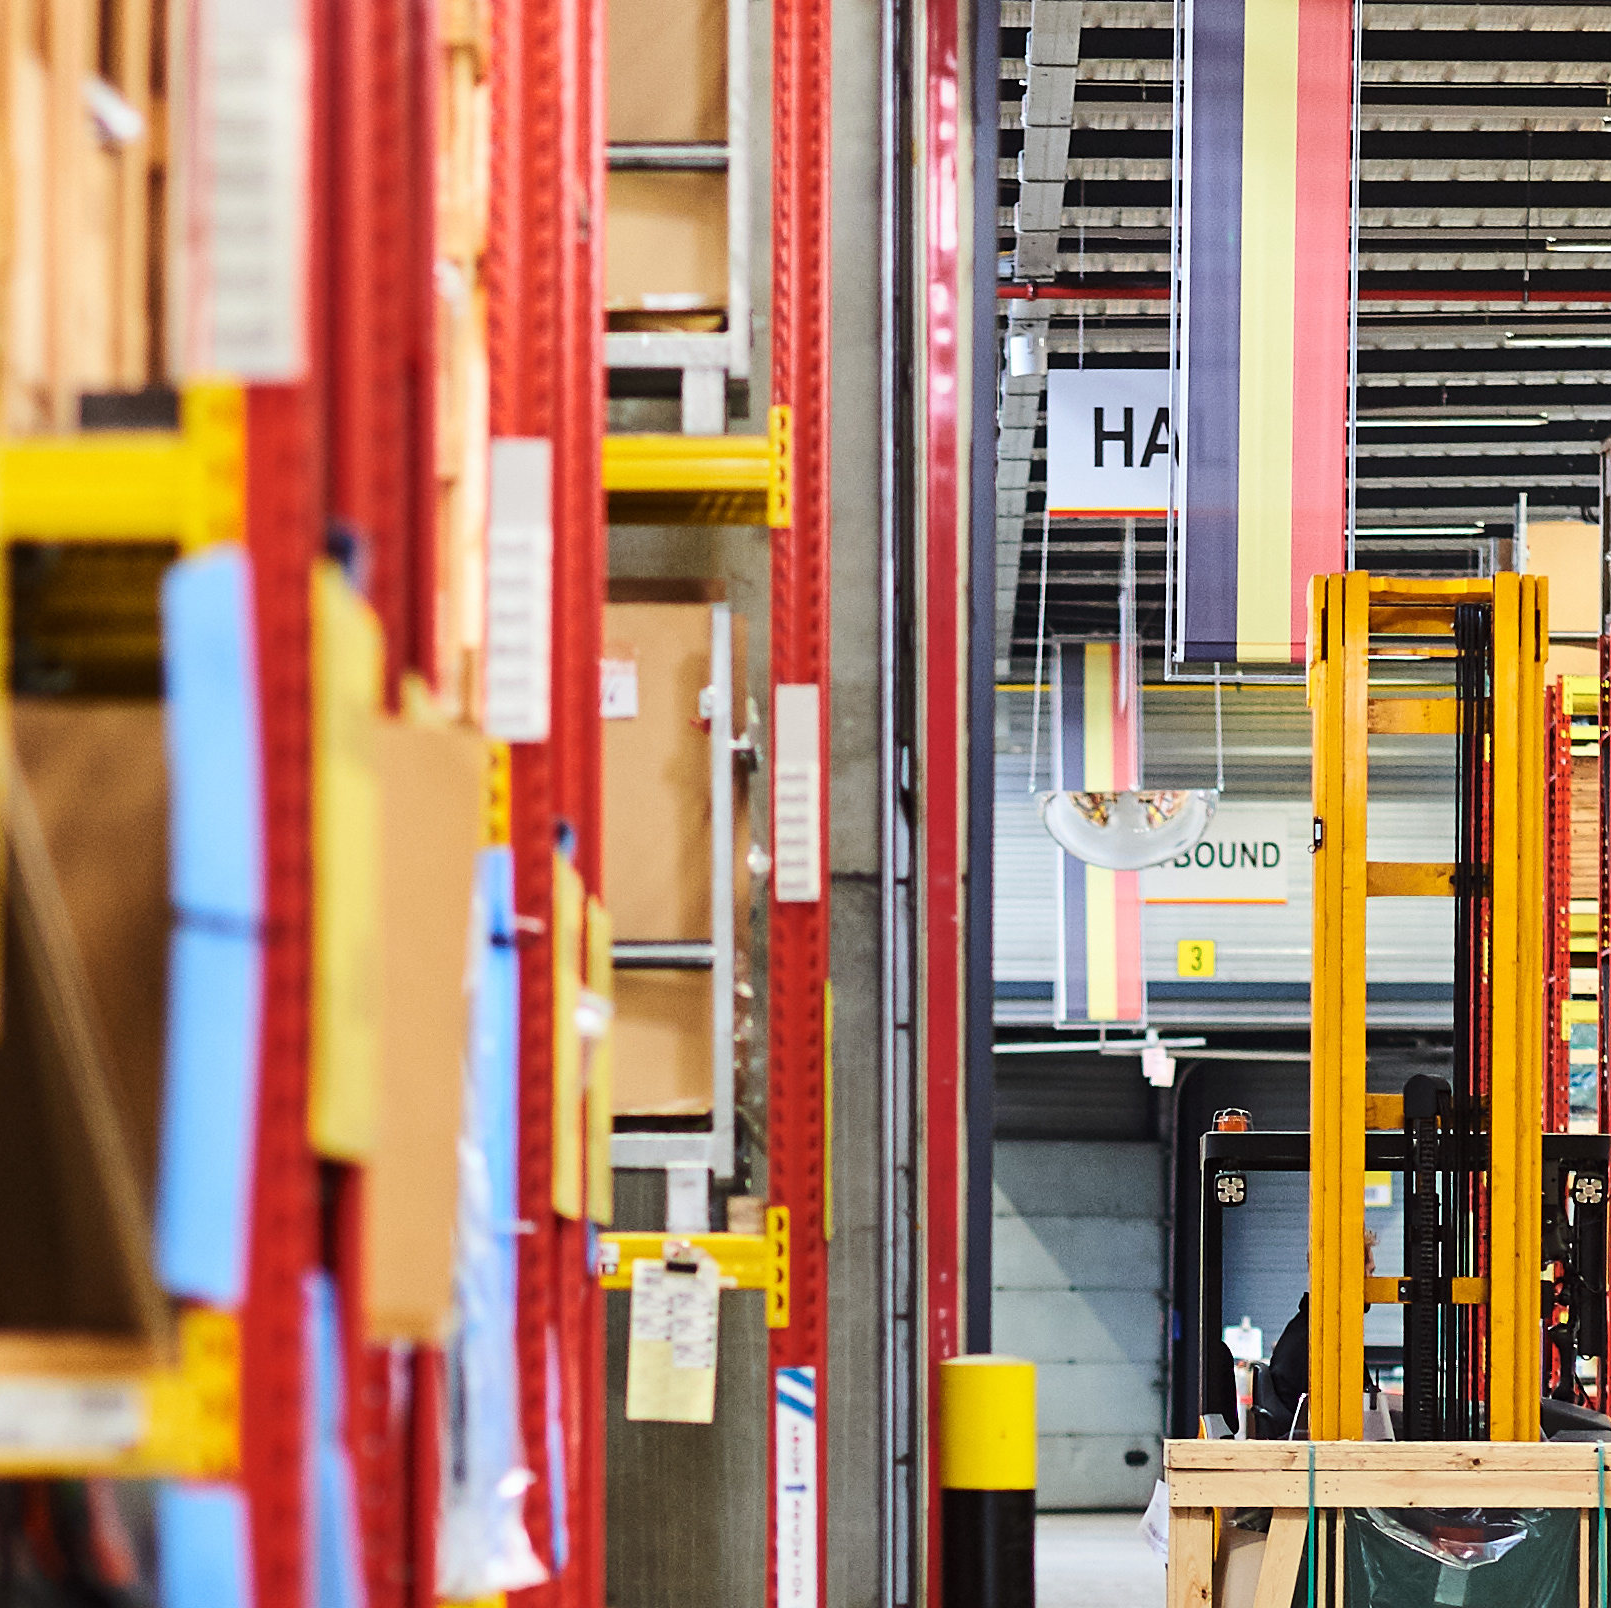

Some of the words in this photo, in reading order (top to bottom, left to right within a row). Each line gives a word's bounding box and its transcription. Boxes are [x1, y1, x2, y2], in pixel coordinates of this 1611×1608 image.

[1093, 406, 1180, 468] HA
[1159, 841, 1281, 868] BOUND
[1190, 946, 1203, 971] 3
